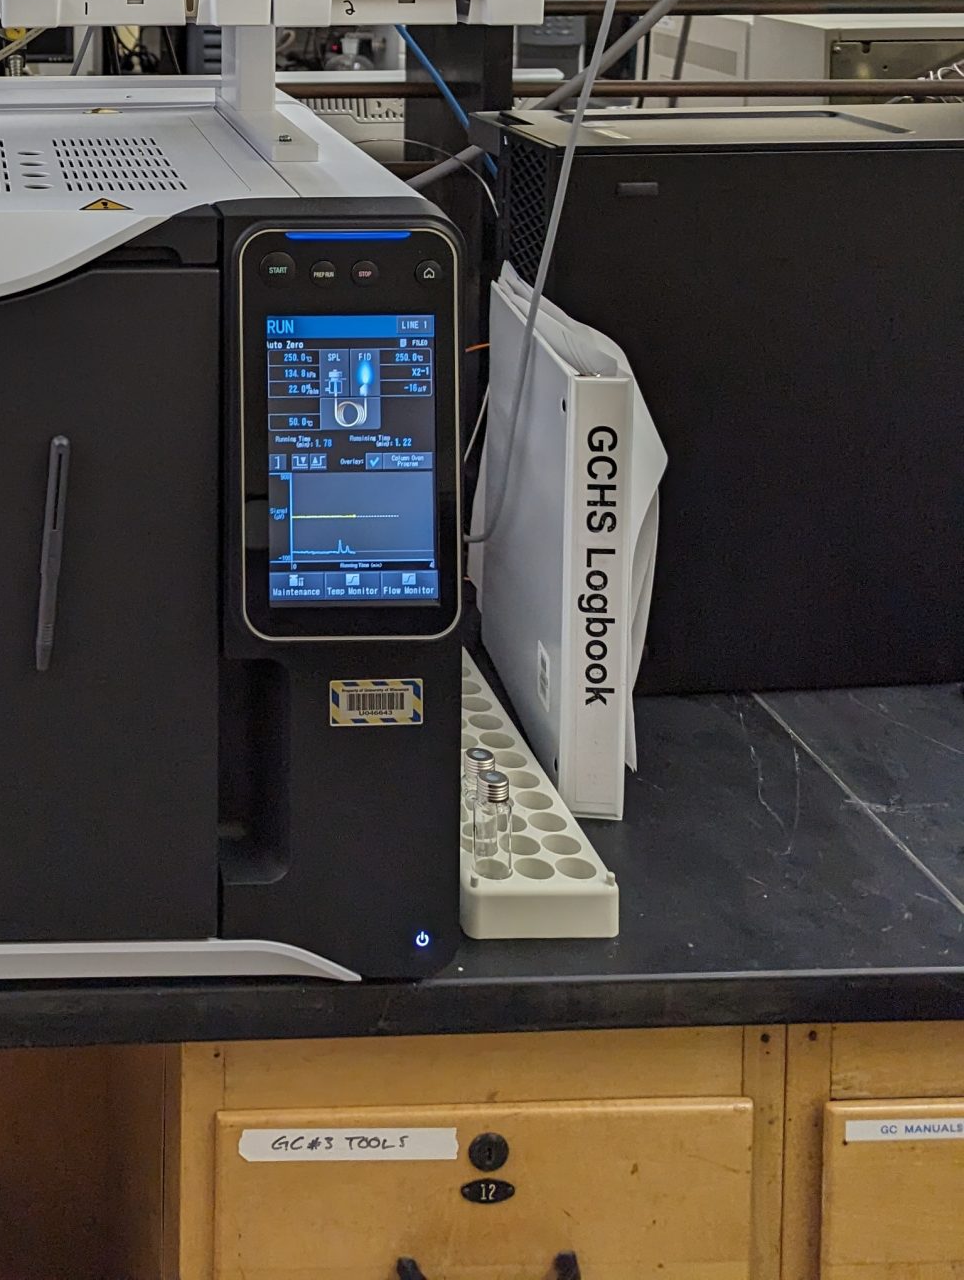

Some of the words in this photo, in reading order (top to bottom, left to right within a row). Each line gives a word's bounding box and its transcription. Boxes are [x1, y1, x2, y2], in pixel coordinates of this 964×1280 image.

[343, 0, 356, 15] 2
[269, 266, 288, 274] START
[267, 319, 294, 334] RUN
[401, 321, 419, 329] LINE
[423, 321, 428, 329] 1
[286, 341, 304, 349] Zero
[327, 353, 340, 362] SPL
[358, 352, 372, 361] FID
[395, 438, 412, 447] 1.22
[586, 425, 618, 533] GCHS
[272, 588, 320, 596] Maintenance
[327, 588, 344, 596] Temp
[345, 587, 378, 595] Monitor
[402, 586, 434, 594] Monitor
[577, 548, 616, 706] Logbook
[880, 1125, 897, 1134] GC
[904, 1123, 963, 1134] MANUALS
[345, 1135, 409, 1150] TOOLS
[480, 1183, 497, 1200] 12
